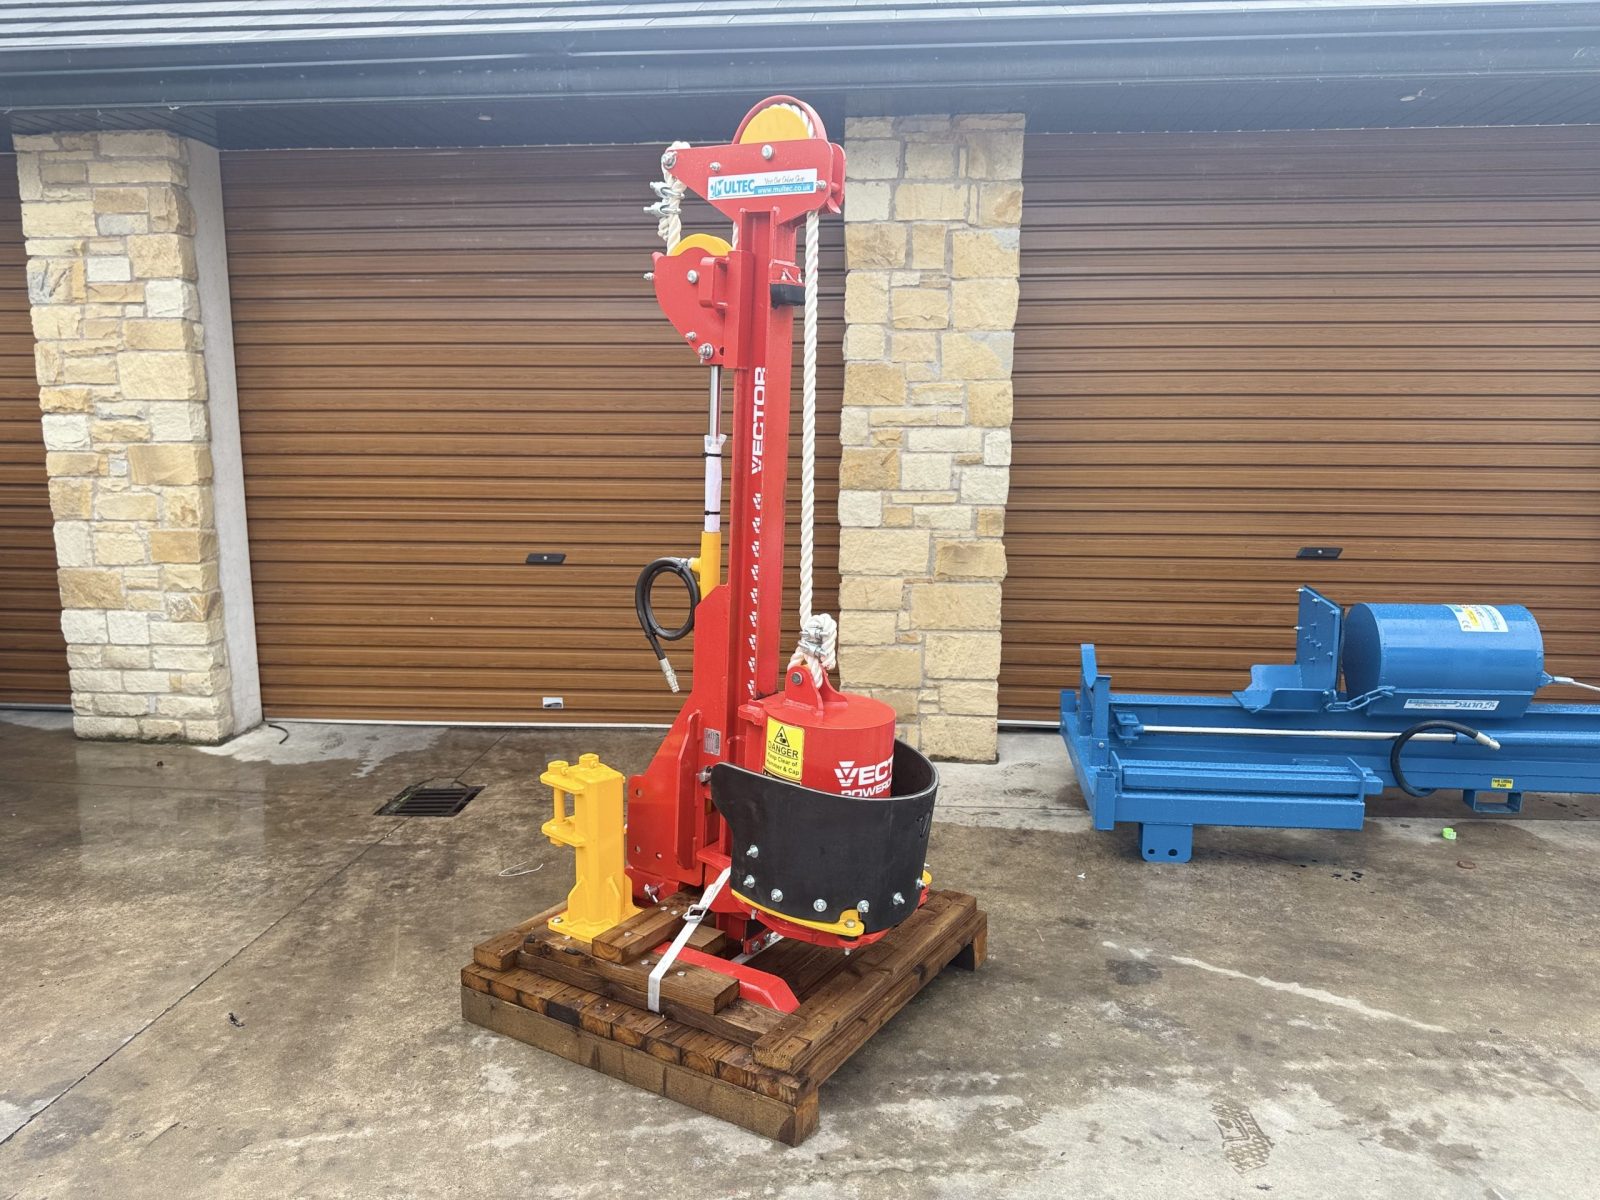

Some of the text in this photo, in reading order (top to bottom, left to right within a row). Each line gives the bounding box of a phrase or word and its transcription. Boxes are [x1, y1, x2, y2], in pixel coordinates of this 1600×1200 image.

[751, 366, 766, 475] VECTOR
[767, 740, 799, 759] DANGER
[788, 767, 800, 776] Cap
